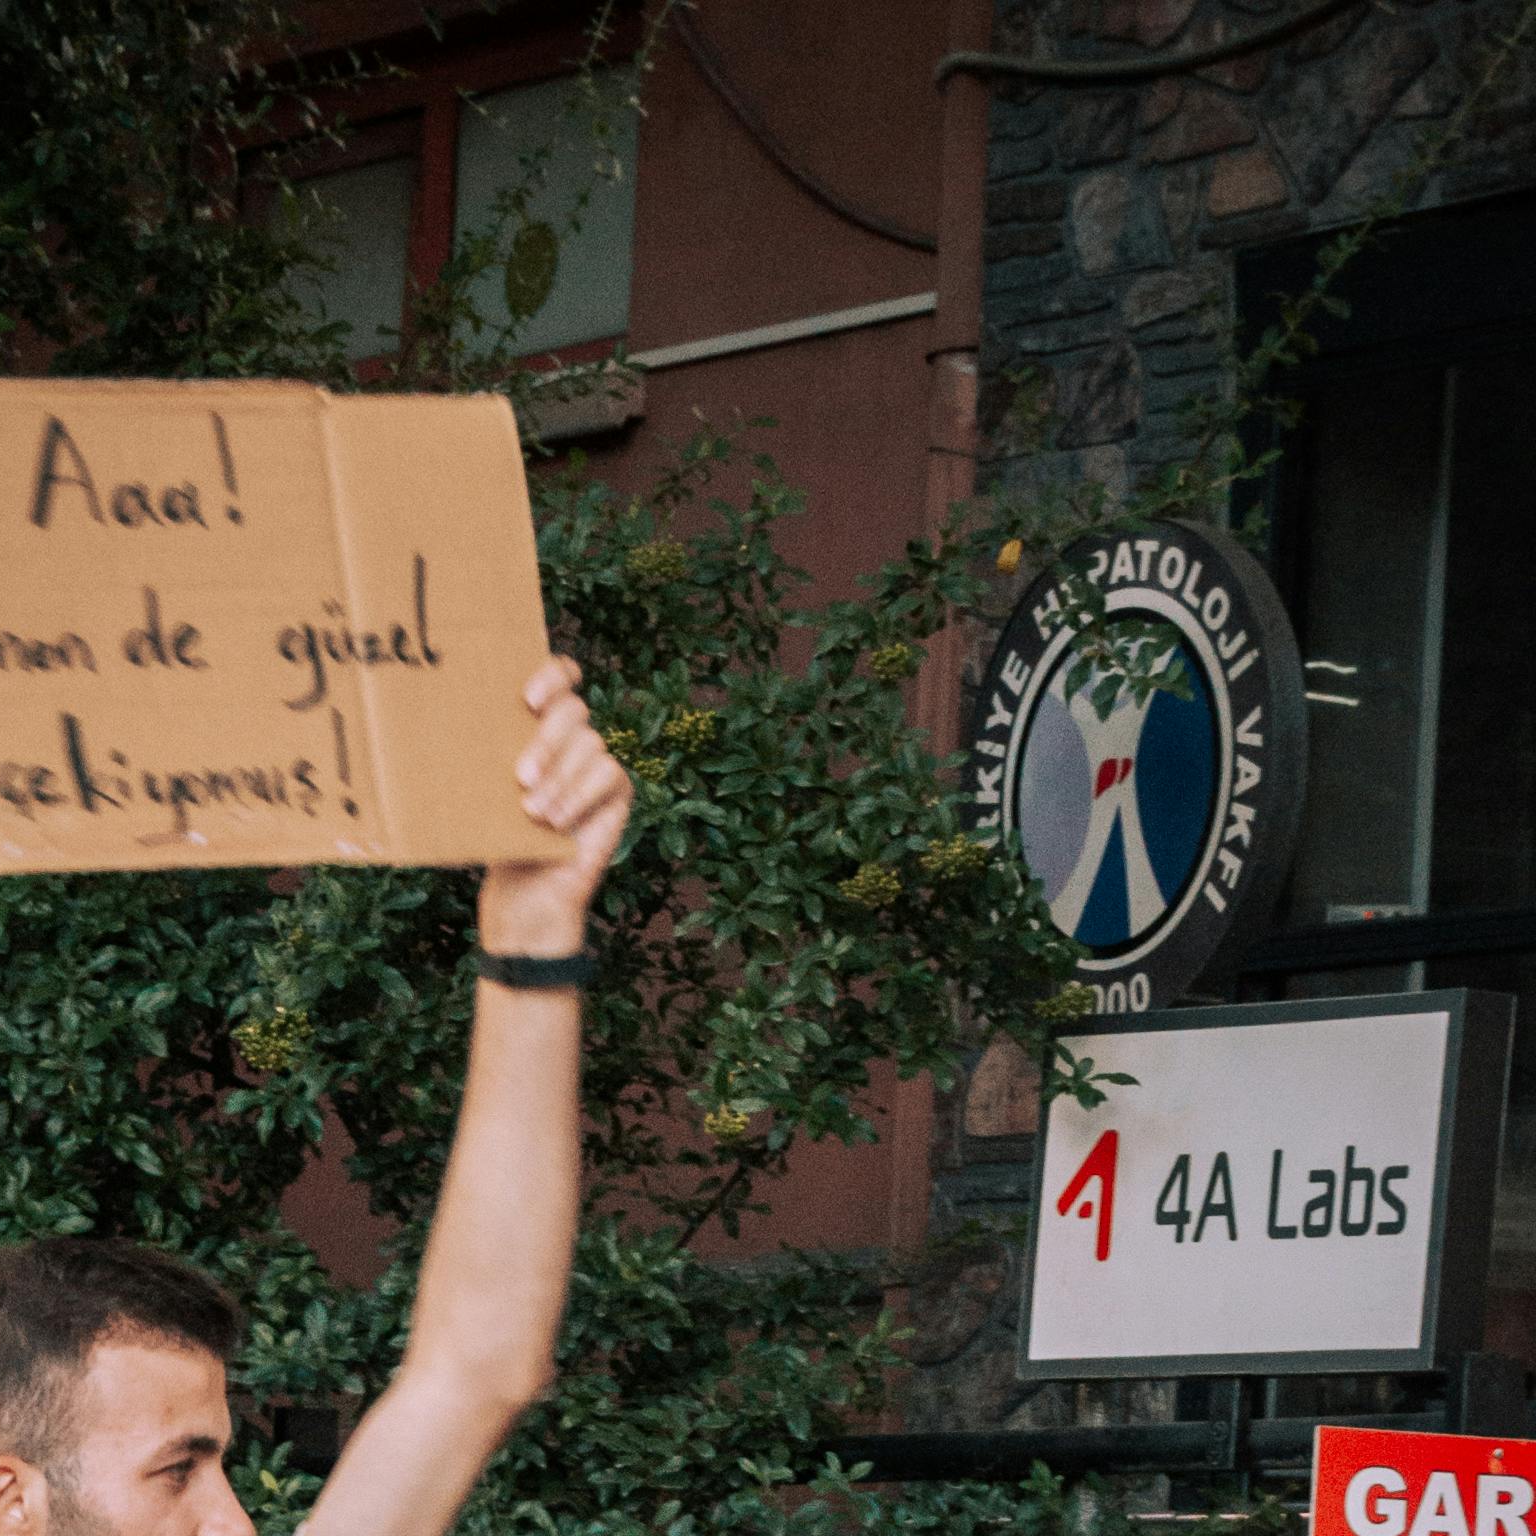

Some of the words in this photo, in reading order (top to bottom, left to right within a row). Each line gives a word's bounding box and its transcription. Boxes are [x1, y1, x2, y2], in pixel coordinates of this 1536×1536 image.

[29, 411, 244, 529] Aaa!
[1204, 705, 1263, 914] VAKFI
[1155, 1150, 1239, 1243] 4A
[1267, 1145, 1410, 1240] Labs
